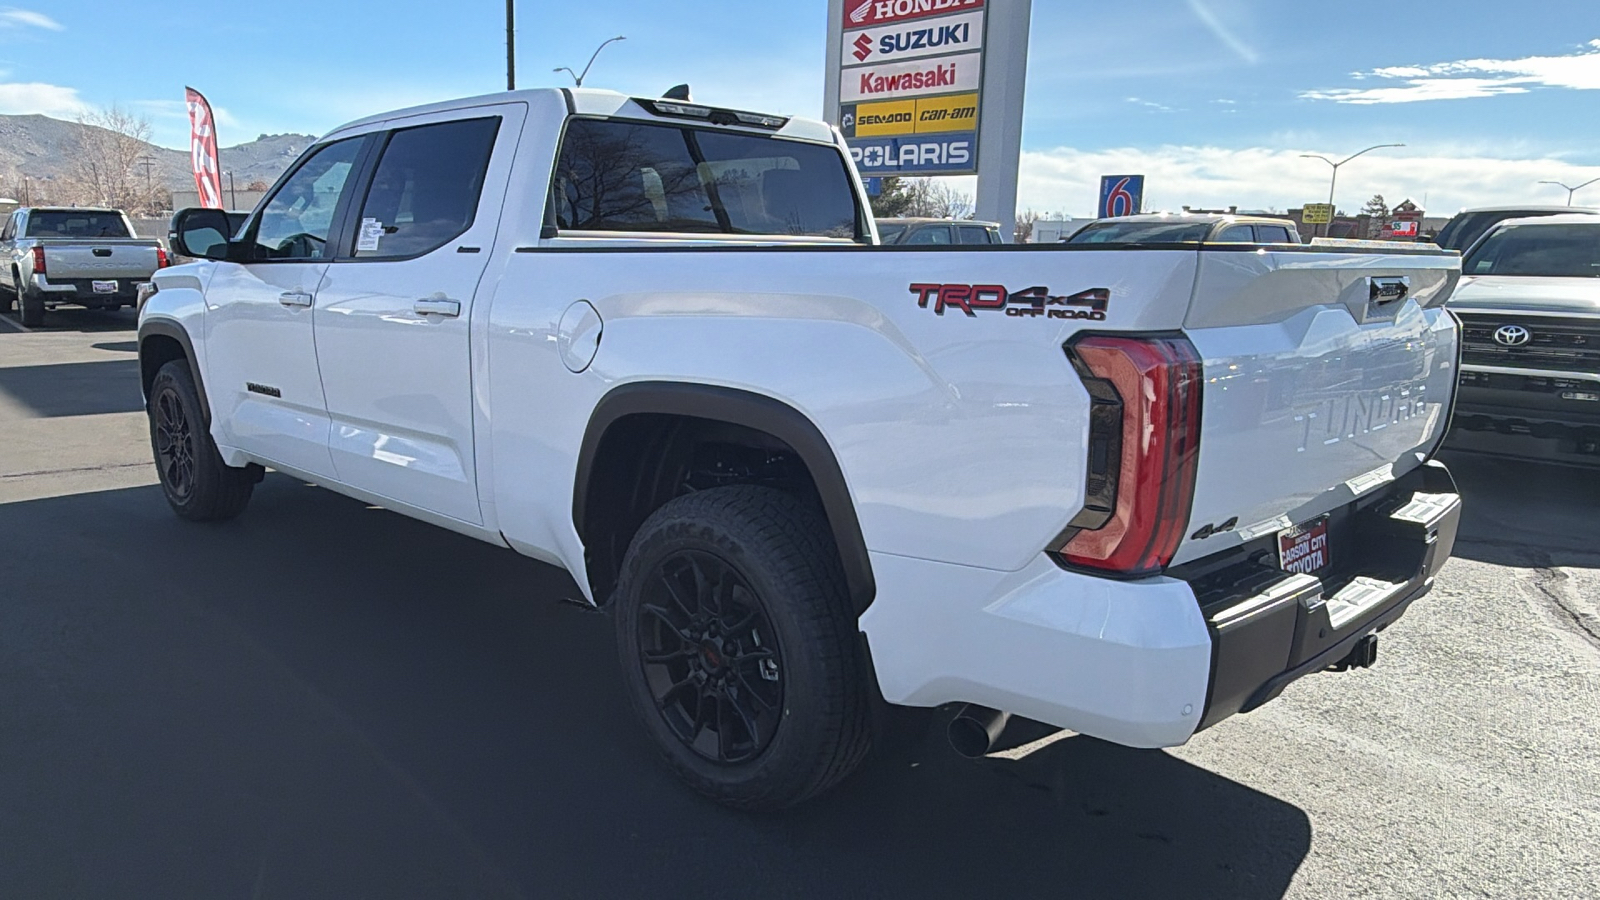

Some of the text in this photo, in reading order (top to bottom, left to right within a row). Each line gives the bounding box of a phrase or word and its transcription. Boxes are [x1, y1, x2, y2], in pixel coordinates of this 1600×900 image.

[879, 22, 969, 54] SUZUKI
[860, 63, 956, 94] Kawasaki
[848, 141, 970, 167] POLARIS
[1106, 177, 1132, 218] 6
[909, 283, 1110, 317] TRD 4x4
[1005, 307, 1107, 321] OFF ROAD
[1294, 386, 1426, 452] TUNDRA
[1191, 516, 1239, 540] 4x4
[1282, 541, 1309, 565] CARSON
[1311, 533, 1326, 550] CITY
[1287, 550, 1323, 573] TOYOTA
